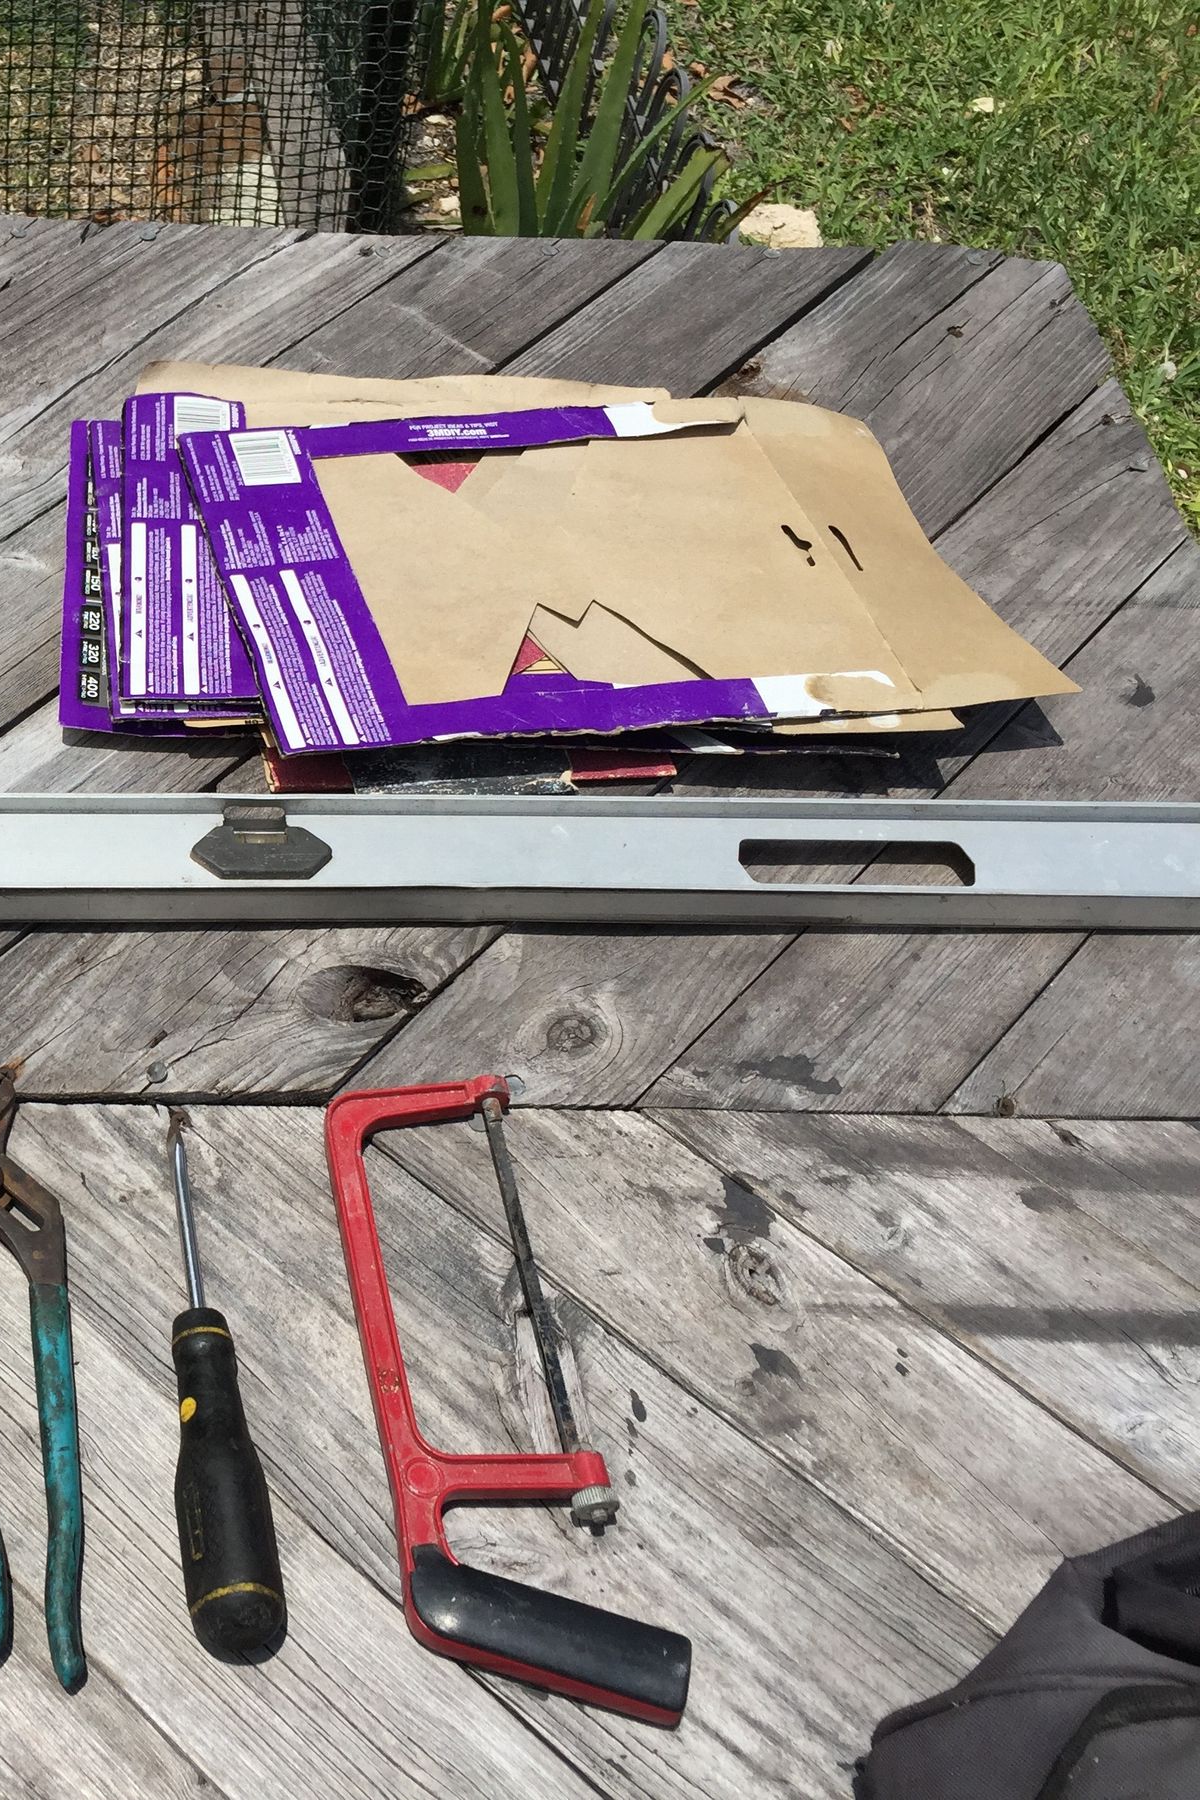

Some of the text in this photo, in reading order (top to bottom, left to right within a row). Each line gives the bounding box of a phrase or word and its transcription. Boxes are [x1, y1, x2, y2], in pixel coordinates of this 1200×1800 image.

[426, 428, 487, 437] 3MDIY.com
[90, 575, 101, 591] 150
[88, 611, 100, 631] 220
[87, 644, 100, 663] 320
[86, 678, 99, 698] 400
